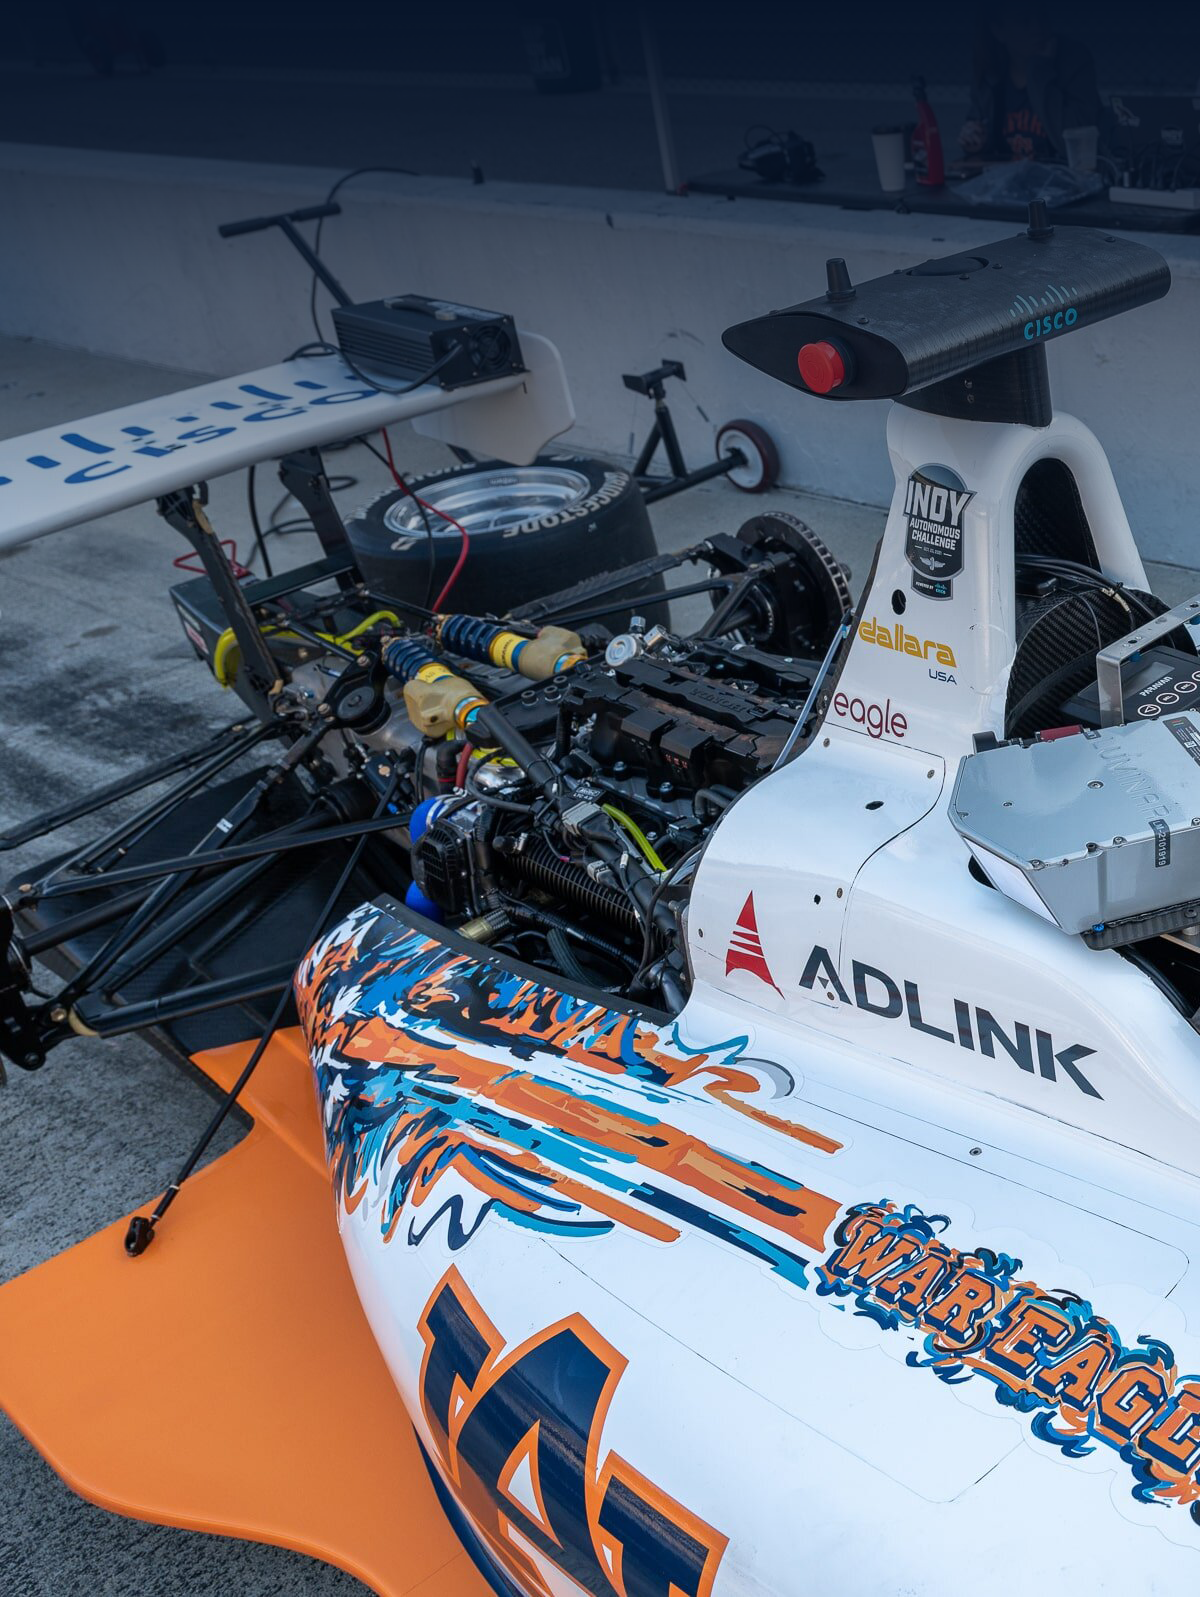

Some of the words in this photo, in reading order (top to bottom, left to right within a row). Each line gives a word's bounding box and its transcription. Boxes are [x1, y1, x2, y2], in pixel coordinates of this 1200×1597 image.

[1024, 308, 1078, 340] CISCO
[64, 389, 380, 484] CISCO
[905, 480, 970, 526] INDY
[909, 518, 960, 539] AUTONOMOUS
[911, 530, 956, 550] CHALLENGE
[858, 617, 957, 668] dallara
[929, 669, 957, 685] USA
[834, 692, 907, 738] eagle
[798, 945, 1105, 1101] ADLINK
[831, 1219, 998, 1344] WAR
